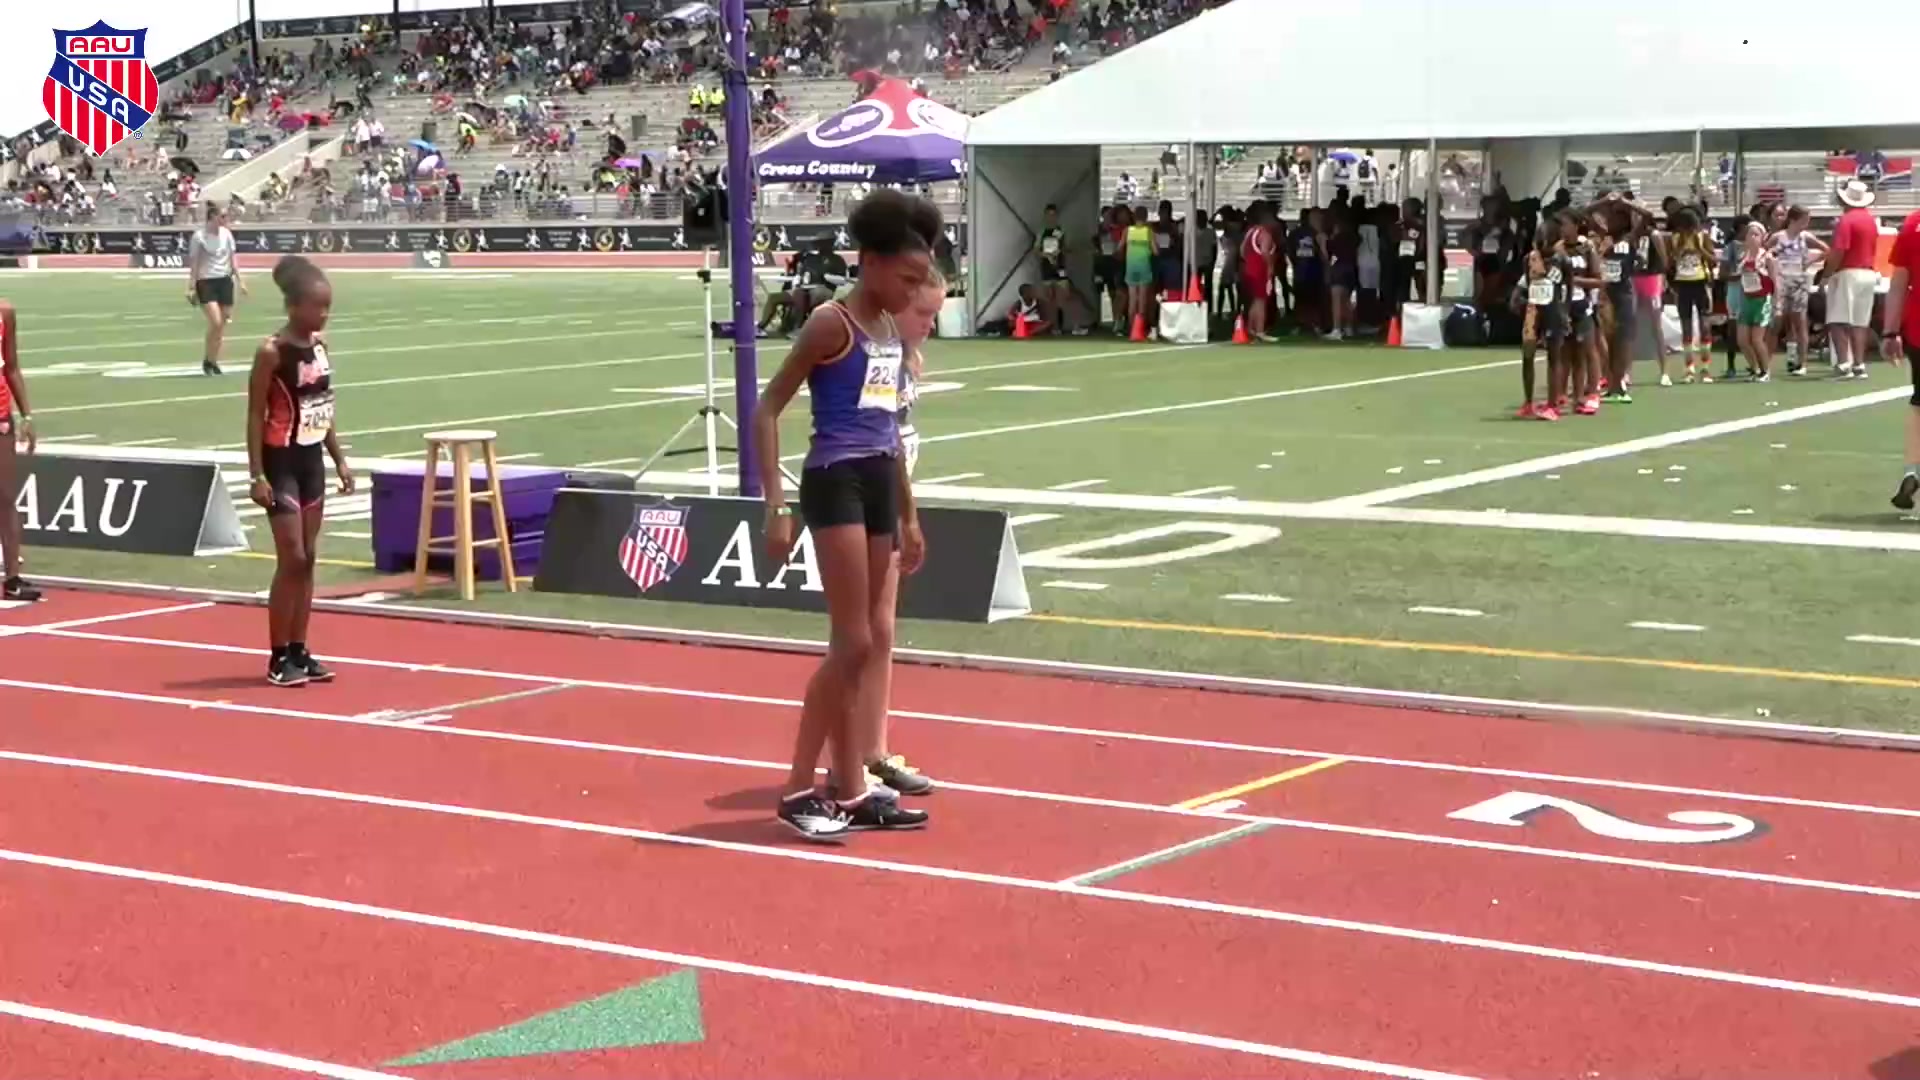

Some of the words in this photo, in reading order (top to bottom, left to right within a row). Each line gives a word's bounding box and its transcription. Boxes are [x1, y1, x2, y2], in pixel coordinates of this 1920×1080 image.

[758, 163, 804, 176] Cross
[807, 160, 876, 179] Country
[15, 473, 148, 536] AAU
[643, 511, 678, 522] AAU
[636, 528, 669, 572] USA
[701, 519, 825, 592] AA
[1447, 790, 1771, 844] 2
